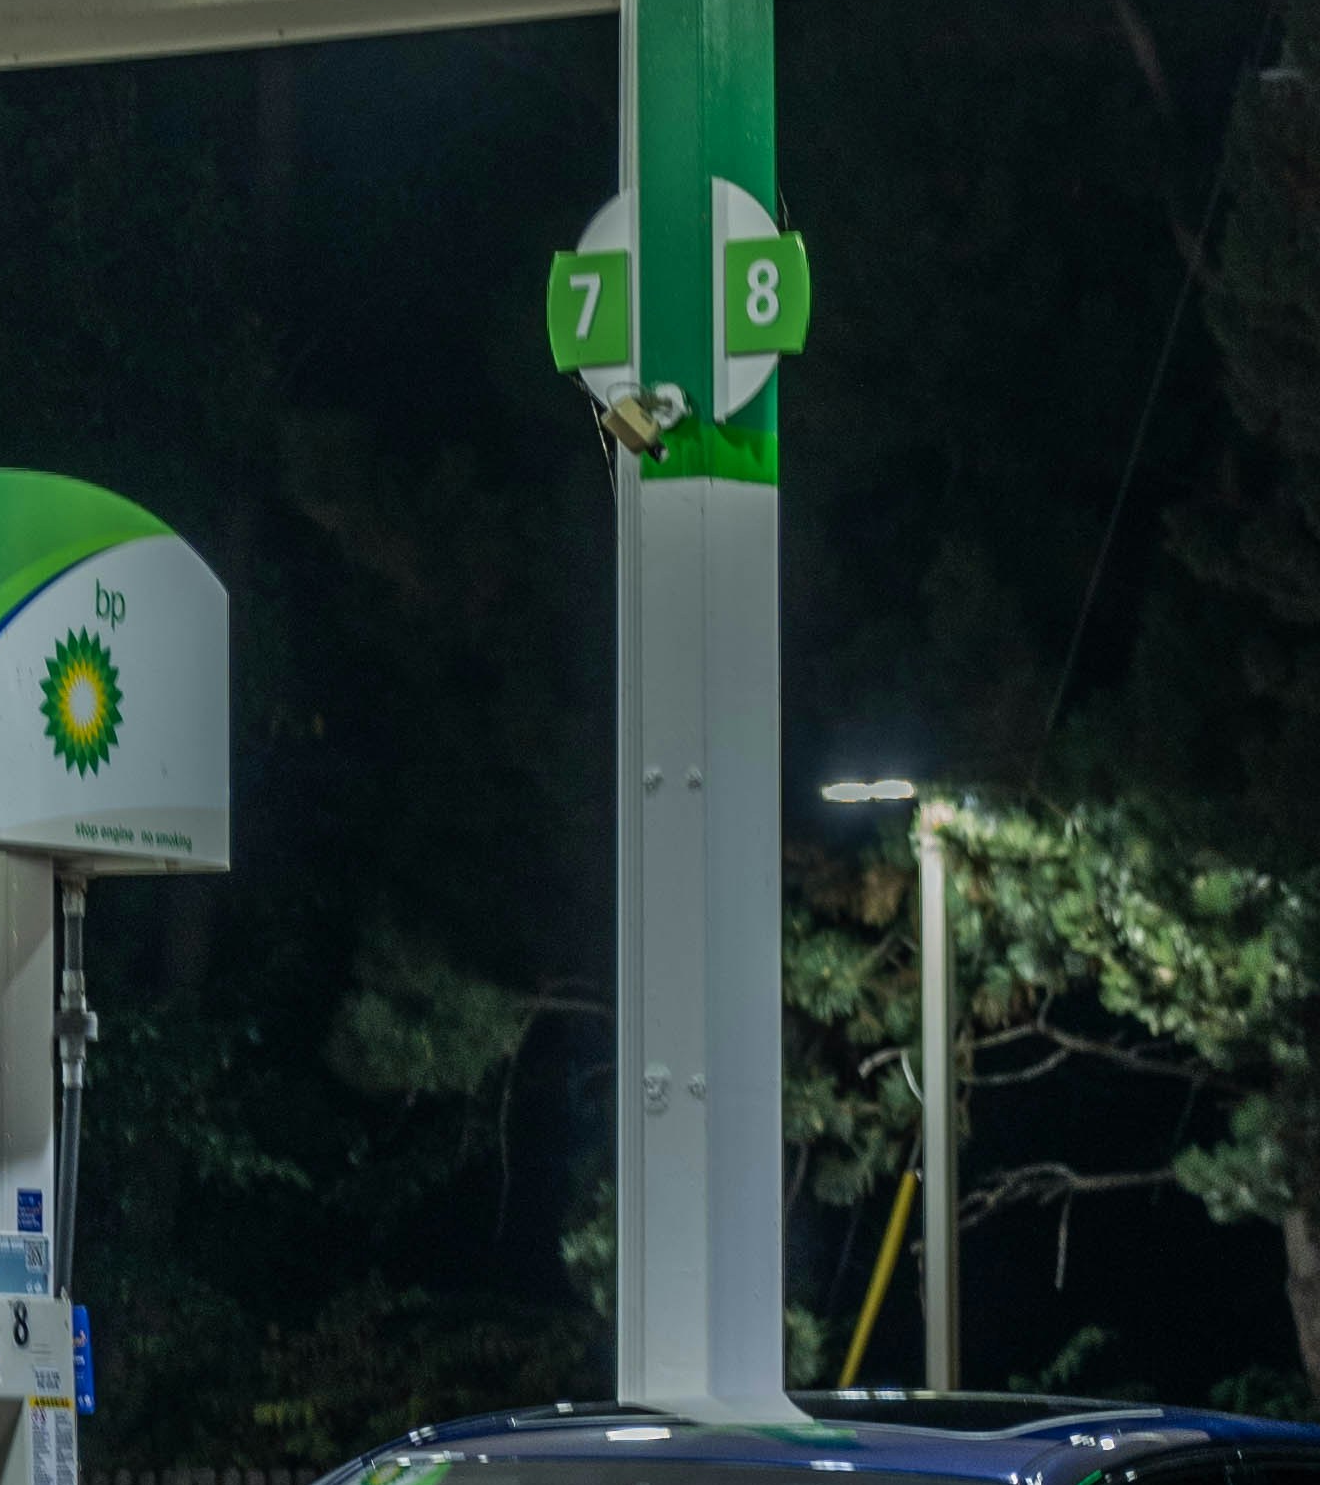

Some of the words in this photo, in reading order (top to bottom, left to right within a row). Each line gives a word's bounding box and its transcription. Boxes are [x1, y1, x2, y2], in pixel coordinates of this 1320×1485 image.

[570, 273, 601, 339] 7
[746, 259, 779, 326] 8
[96, 578, 125, 632] bp
[75, 821, 98, 840] stop
[100, 824, 134, 844] engine
[141, 828, 154, 844] no
[155, 830, 192, 852] smoking
[13, 1300, 28, 1345] 8
